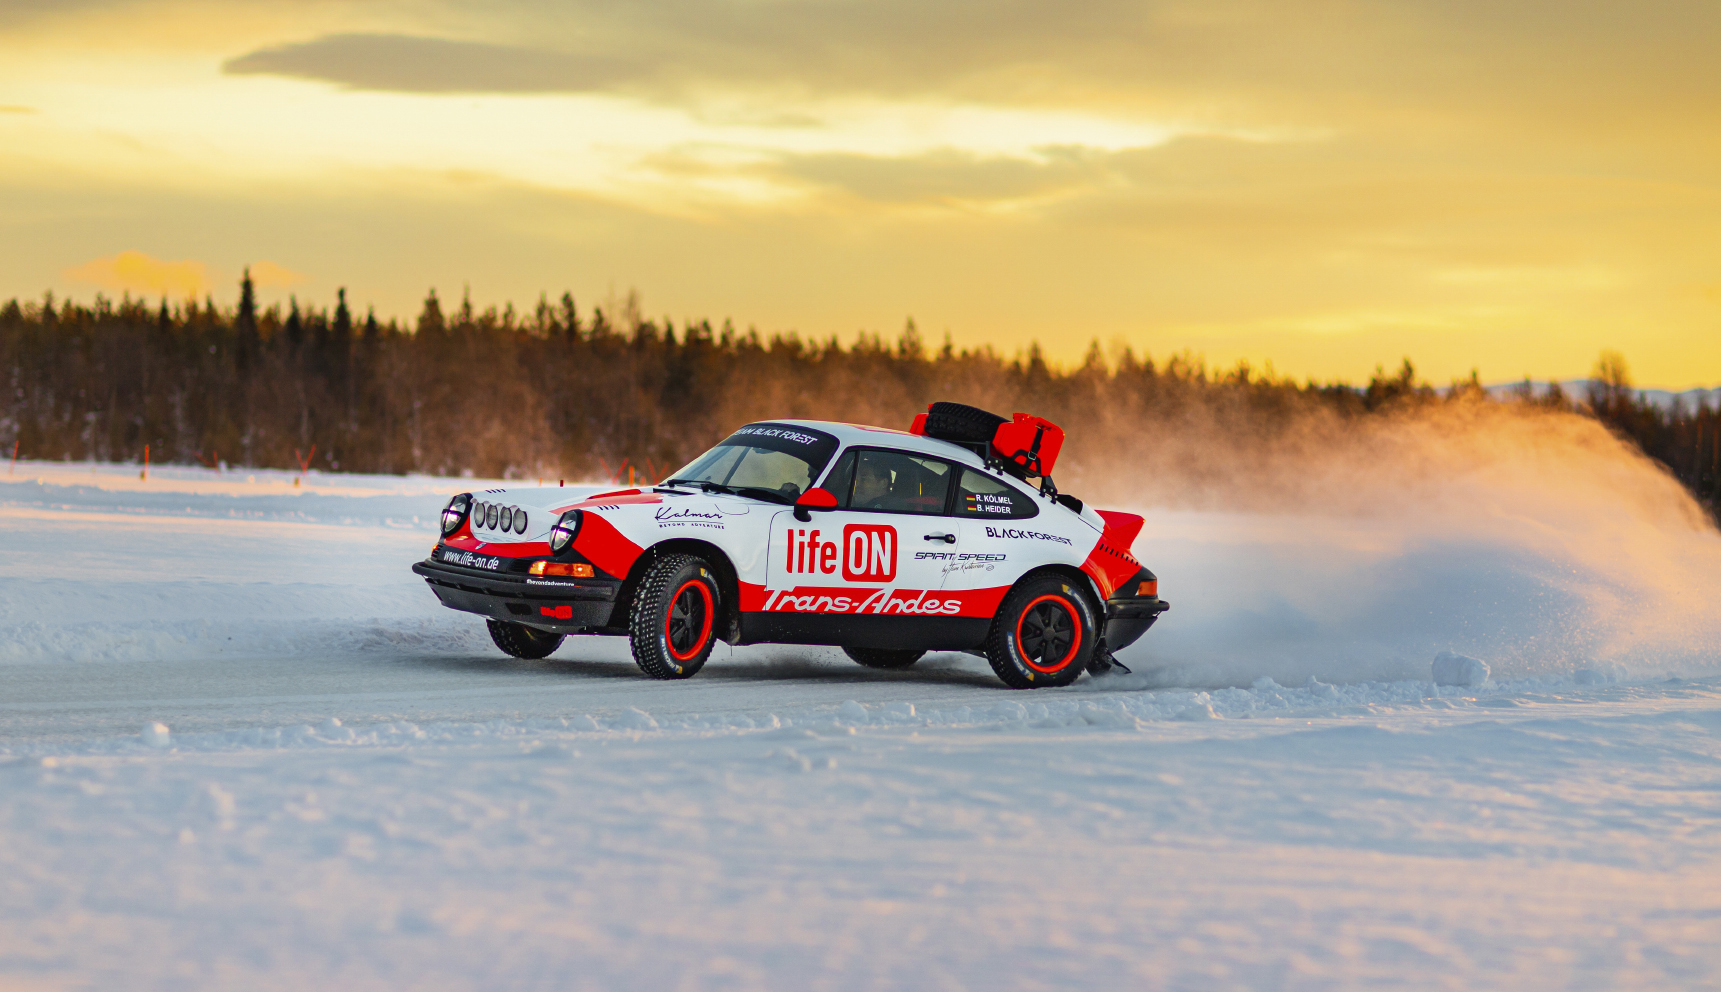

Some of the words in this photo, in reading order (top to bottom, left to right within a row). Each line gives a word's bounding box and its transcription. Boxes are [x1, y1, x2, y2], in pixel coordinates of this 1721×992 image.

[752, 428, 783, 437] BLACK
[779, 430, 818, 445] FOREST
[975, 494, 983, 502] R.
[654, 506, 723, 521] Kalmar
[977, 504, 984, 512] B.
[985, 505, 1012, 514] HEIDER
[443, 550, 500, 570] www.life-on.de
[914, 552, 956, 560] SPIRIT
[958, 553, 1007, 561] SPEED
[762, 587, 962, 614] Trans-Andes
